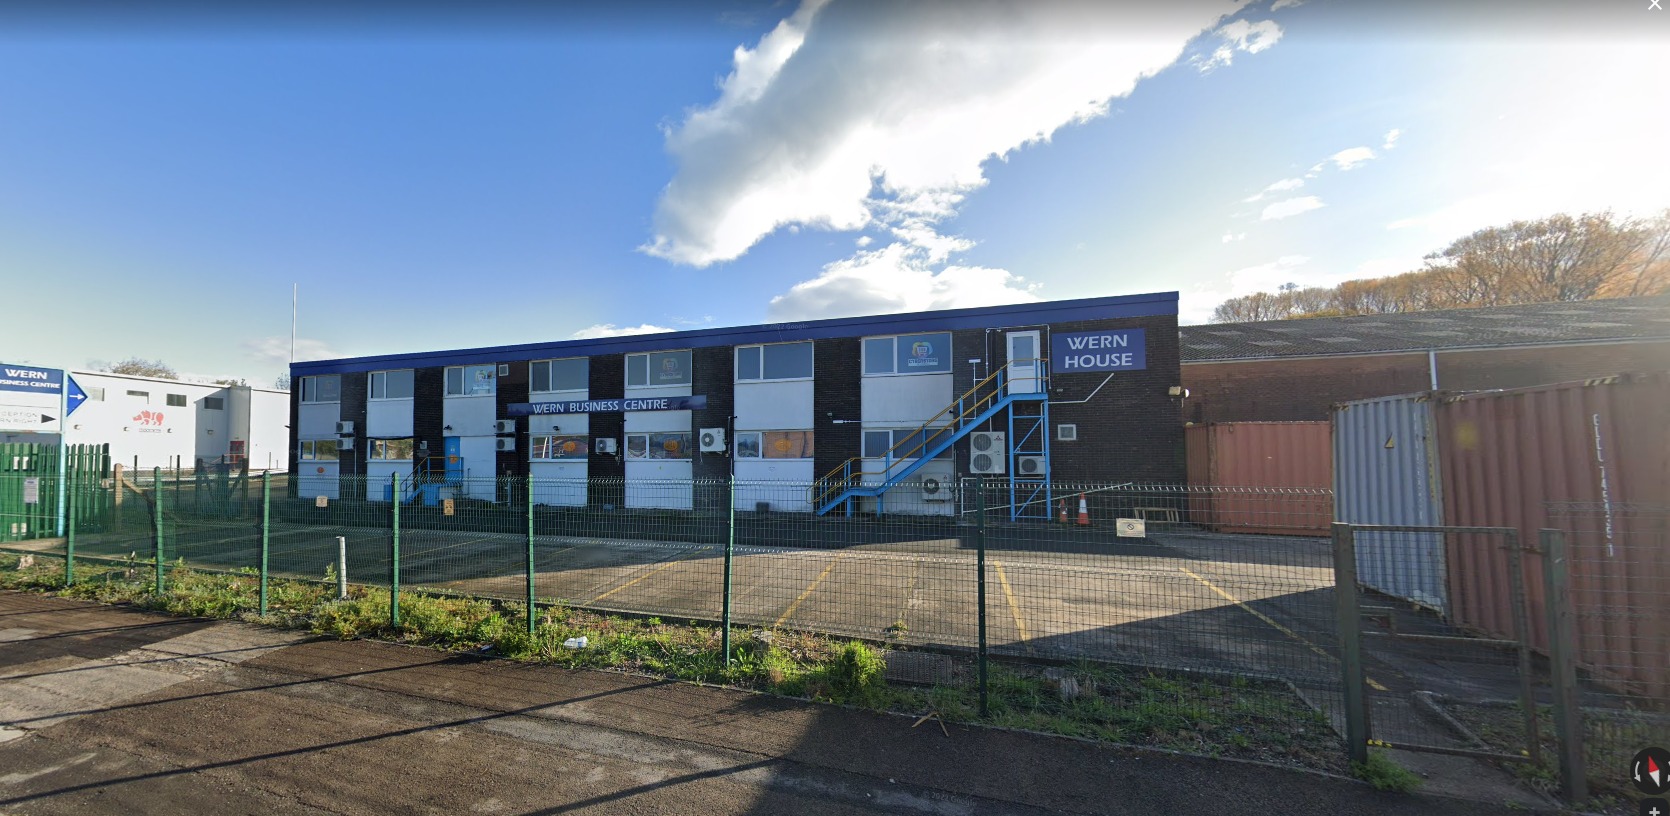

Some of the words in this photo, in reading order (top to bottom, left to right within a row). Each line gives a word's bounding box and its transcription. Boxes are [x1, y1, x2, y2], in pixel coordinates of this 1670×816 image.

[1067, 334, 1128, 350] WERN
[1064, 352, 1133, 369] HOUSE
[5, 368, 48, 380] WERN
[0, 379, 29, 387] SINESS
[532, 403, 565, 414] WERN
[569, 400, 619, 413] BUSINESS
[623, 399, 668, 411] CENTRE
